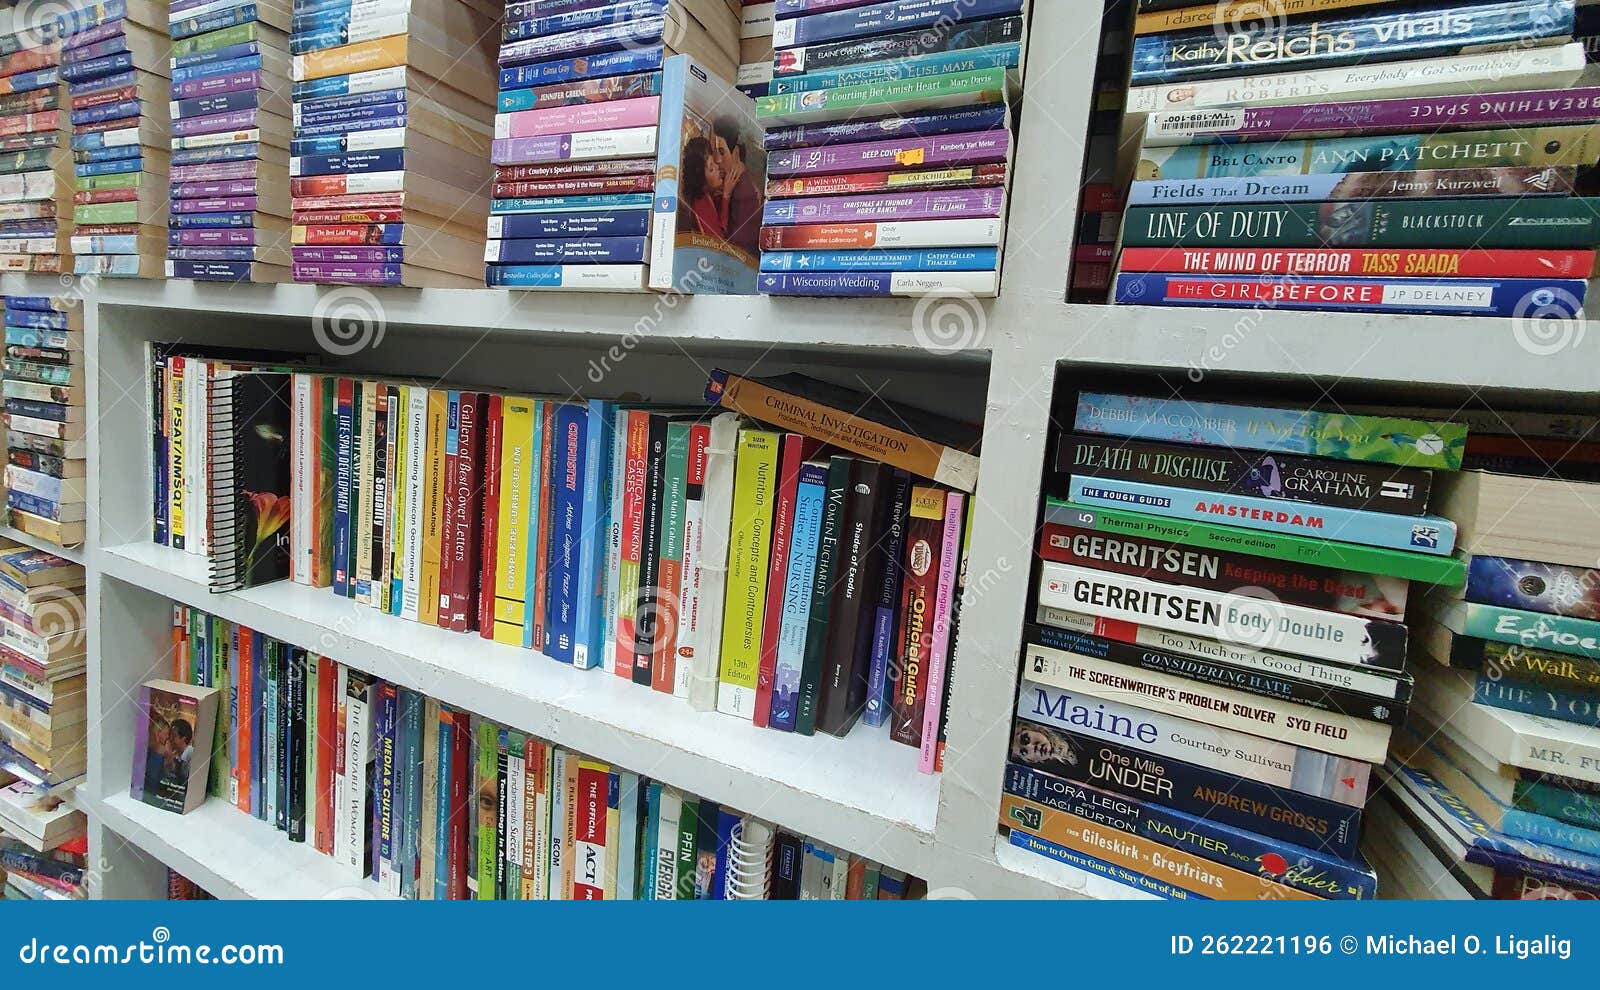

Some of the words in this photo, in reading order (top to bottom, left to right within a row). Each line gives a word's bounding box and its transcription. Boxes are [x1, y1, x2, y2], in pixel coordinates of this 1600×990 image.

[1171, 43, 1226, 62] Kathy
[1227, 22, 1356, 64] Reichs
[1373, 12, 1474, 42] virals
[943, 61, 974, 73] MAYR
[1243, 75, 1317, 88] ROBIN
[1422, 66, 1444, 76] Got
[1450, 60, 1521, 74] Something
[832, 90, 867, 101] Courting
[869, 88, 884, 98] Her
[886, 85, 914, 96] Amish
[916, 81, 940, 92] Heart
[950, 78, 969, 88] Mary
[971, 75, 992, 84] Davis
[1226, 84, 1329, 101] ROBERTS
[1212, 155, 1239, 167] BEL
[1244, 153, 1297, 167] CANTO
[1315, 150, 1369, 164] ANN
[1380, 142, 1528, 162] PATCHETT
[1152, 185, 1204, 198] Fields
[1211, 188, 1237, 197] That
[1246, 182, 1309, 195] Dream
[1389, 180, 1432, 193] Jenny
[1437, 178, 1501, 190] Kurzweil
[1148, 213, 1188, 239] LINE
[1196, 212, 1223, 238] OF
[1231, 211, 1289, 238] DUTY
[1403, 215, 1484, 228] BLACKSTOCK
[1184, 252, 1210, 269] THE
[1214, 253, 1256, 271] MIND
[1262, 253, 1283, 271] OF
[1288, 252, 1350, 272] TERROR
[1362, 253, 1400, 272] TASS
[1404, 254, 1459, 273] SAADA
[793, 277, 836, 286] Wisconsin
[839, 277, 879, 290] Wedding
[916, 279, 943, 288] Neggers
[1178, 285, 1202, 295] THE
[1211, 284, 1266, 298] GIRL
[1271, 281, 1384, 301] BEFORE
[1391, 289, 1406, 299] JP
[1415, 290, 1486, 300] DELANEY
[338, 415, 350, 456] LIFE-SPAN
[458, 404, 474, 448] Gallery
[765, 395, 816, 422] CRIMINAL
[820, 413, 908, 453] INVESTIGATION
[1089, 407, 1137, 422] DEBBIE
[1144, 412, 1237, 432] MACOMBER
[172, 407, 183, 511] PSAT/NMSQT
[412, 414, 421, 482] Understanding
[566, 422, 579, 492] CHEMISTRY
[695, 434, 704, 481] ACCOUNTING
[1073, 444, 1132, 470] DEATH
[1138, 454, 1151, 469] IN
[1153, 454, 1232, 482] DISGUISE
[337, 458, 350, 514] DEVELOPMENT
[627, 459, 636, 492] CASES
[634, 459, 646, 506] CRITICAL
[757, 462, 769, 506] Nutrition
[1285, 478, 1371, 498] GRAHAM
[1294, 468, 1367, 484] CAROLINE
[411, 483, 419, 524] American
[458, 488, 471, 520] Cover
[823, 487, 844, 540] WOMEN
[1083, 488, 1099, 496] THE
[1103, 490, 1135, 501] ROUGH
[1139, 495, 1169, 506] GUIDE
[1195, 501, 1324, 529] AMSTERDAM
[456, 522, 469, 562] Letters
[630, 508, 642, 561] THINKING
[752, 518, 765, 563] Concepts
[852, 522, 864, 553] Shades
[1102, 516, 1144, 530] Thermal
[1148, 524, 1189, 537] Physics
[1208, 532, 1242, 545] Second
[1244, 538, 1276, 551] edition
[408, 528, 417, 582] Government
[751, 564, 759, 581] and
[1073, 534, 1219, 579] GERRITSEN
[787, 550, 804, 615] NURSING
[846, 564, 858, 599] Exodus
[744, 582, 759, 650] Controversies
[1074, 580, 1222, 627] GERRITSEN
[1227, 608, 1272, 632] Body
[1279, 617, 1344, 643] Double
[727, 668, 750, 682] Edition
[733, 658, 748, 670] 13th
[1142, 652, 1247, 686] CONSIDERING
[1250, 677, 1293, 695] HATE
[1160, 633, 1183, 648] Too
[1187, 638, 1229, 660] Much
[1263, 656, 1301, 673] Good
[1308, 664, 1352, 686] Thing
[1525, 656, 1580, 680] Walk
[1069, 666, 1086, 679] THE
[1089, 671, 1175, 701] SCREENWRITER'S
[1179, 691, 1230, 714] PROBLEM
[1233, 704, 1276, 724] SOLVER
[1287, 716, 1310, 731] SYD
[1314, 723, 1348, 740] FIELD
[1032, 688, 1158, 744] Maine
[1170, 733, 1232, 758] Courtney
[1235, 750, 1292, 772] Sullivan
[384, 737, 393, 776] MEDIA
[1099, 748, 1130, 767] One
[1134, 757, 1165, 776] Mile
[1529, 747, 1570, 765] MR.
[381, 788, 392, 841] CULTURE
[1042, 796, 1071, 811] JACI
[1075, 806, 1137, 833] BURTON
[1044, 780, 1086, 799] LORA
[1092, 794, 1139, 818] LEIGH
[1089, 759, 1173, 799] UNDER
[1193, 785, 1267, 817] ANDREW
[1269, 807, 1328, 834] GROSS
[588, 801, 596, 839] OFFICIAL
[553, 837, 561, 867] BCOM
[681, 831, 693, 862] PFIN
[1082, 829, 1139, 860] Gileskirk
[1152, 853, 1224, 889] Greyfriars
[1148, 819, 1229, 857] NAUTIER
[1231, 852, 1250, 862] AND
[586, 846, 596, 883] ACT
[1029, 839, 1047, 852] How
[1050, 845, 1058, 854] to
[1059, 850, 1079, 863] Own
[1088, 860, 1106, 872] Gun
[1119, 871, 1138, 886] Stay
[1140, 874, 1157, 890] Out
